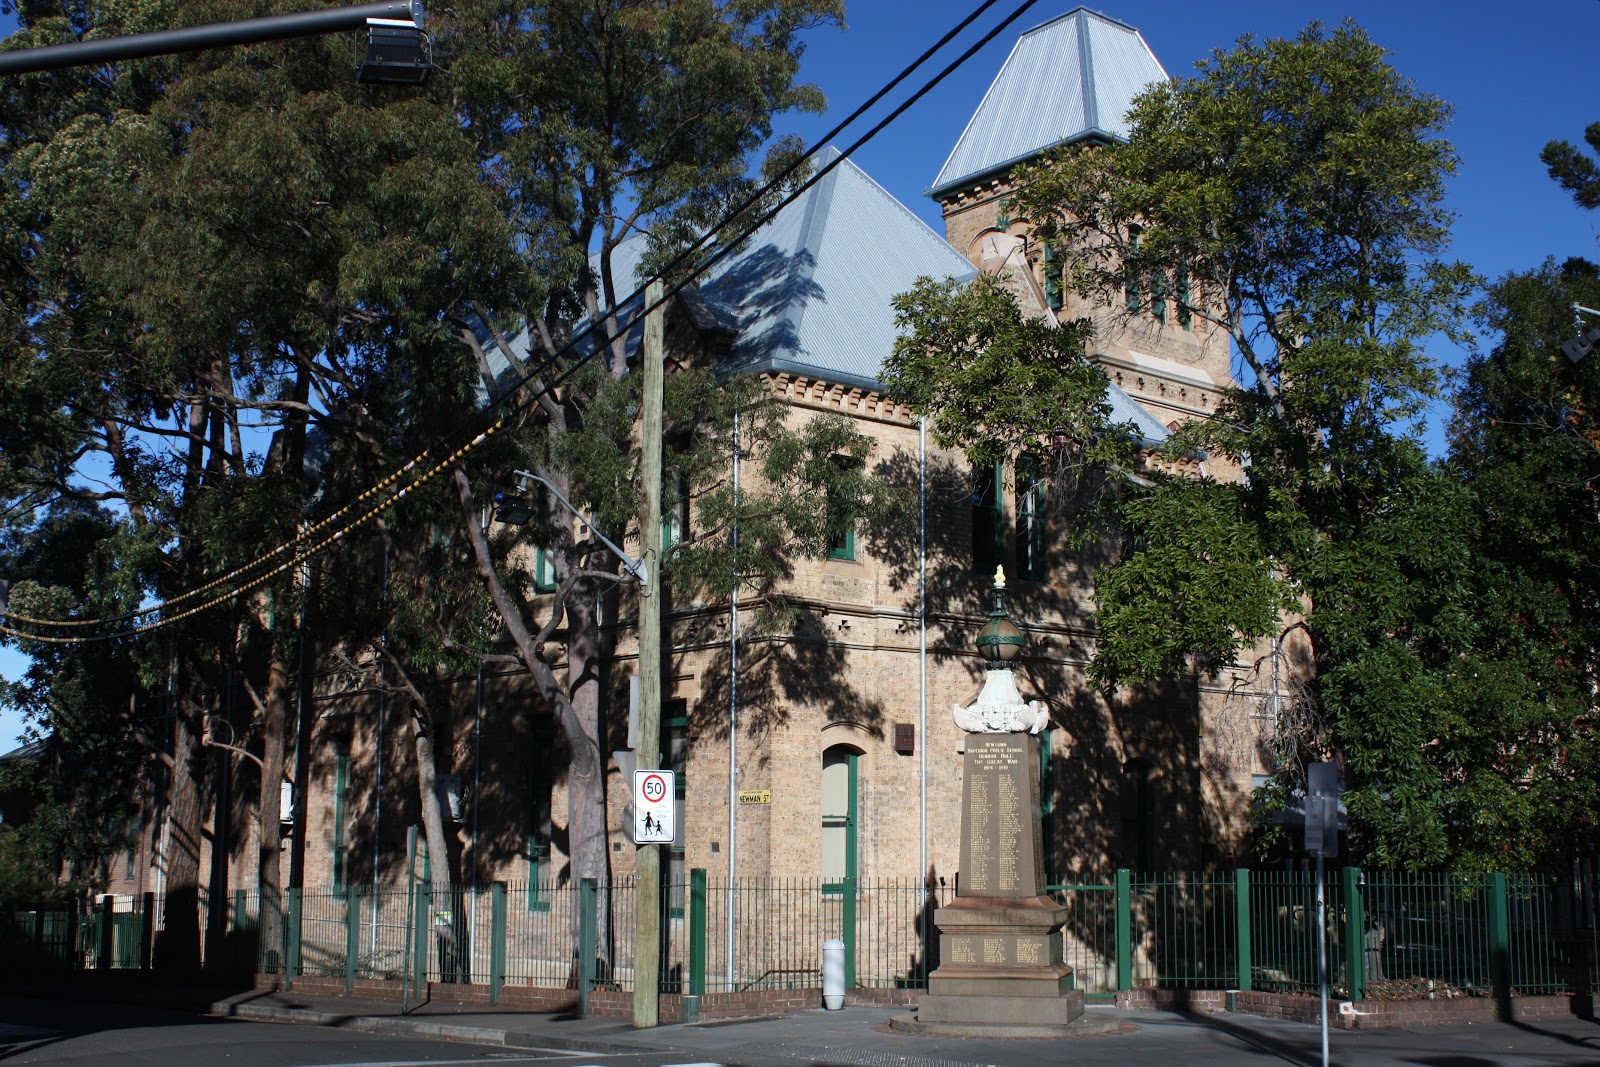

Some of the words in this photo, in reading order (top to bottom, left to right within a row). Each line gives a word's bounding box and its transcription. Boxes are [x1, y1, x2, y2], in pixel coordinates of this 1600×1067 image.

[646, 782, 662, 795] 50
[739, 795, 761, 803] NEWMAN
[763, 794, 770, 803] ST
